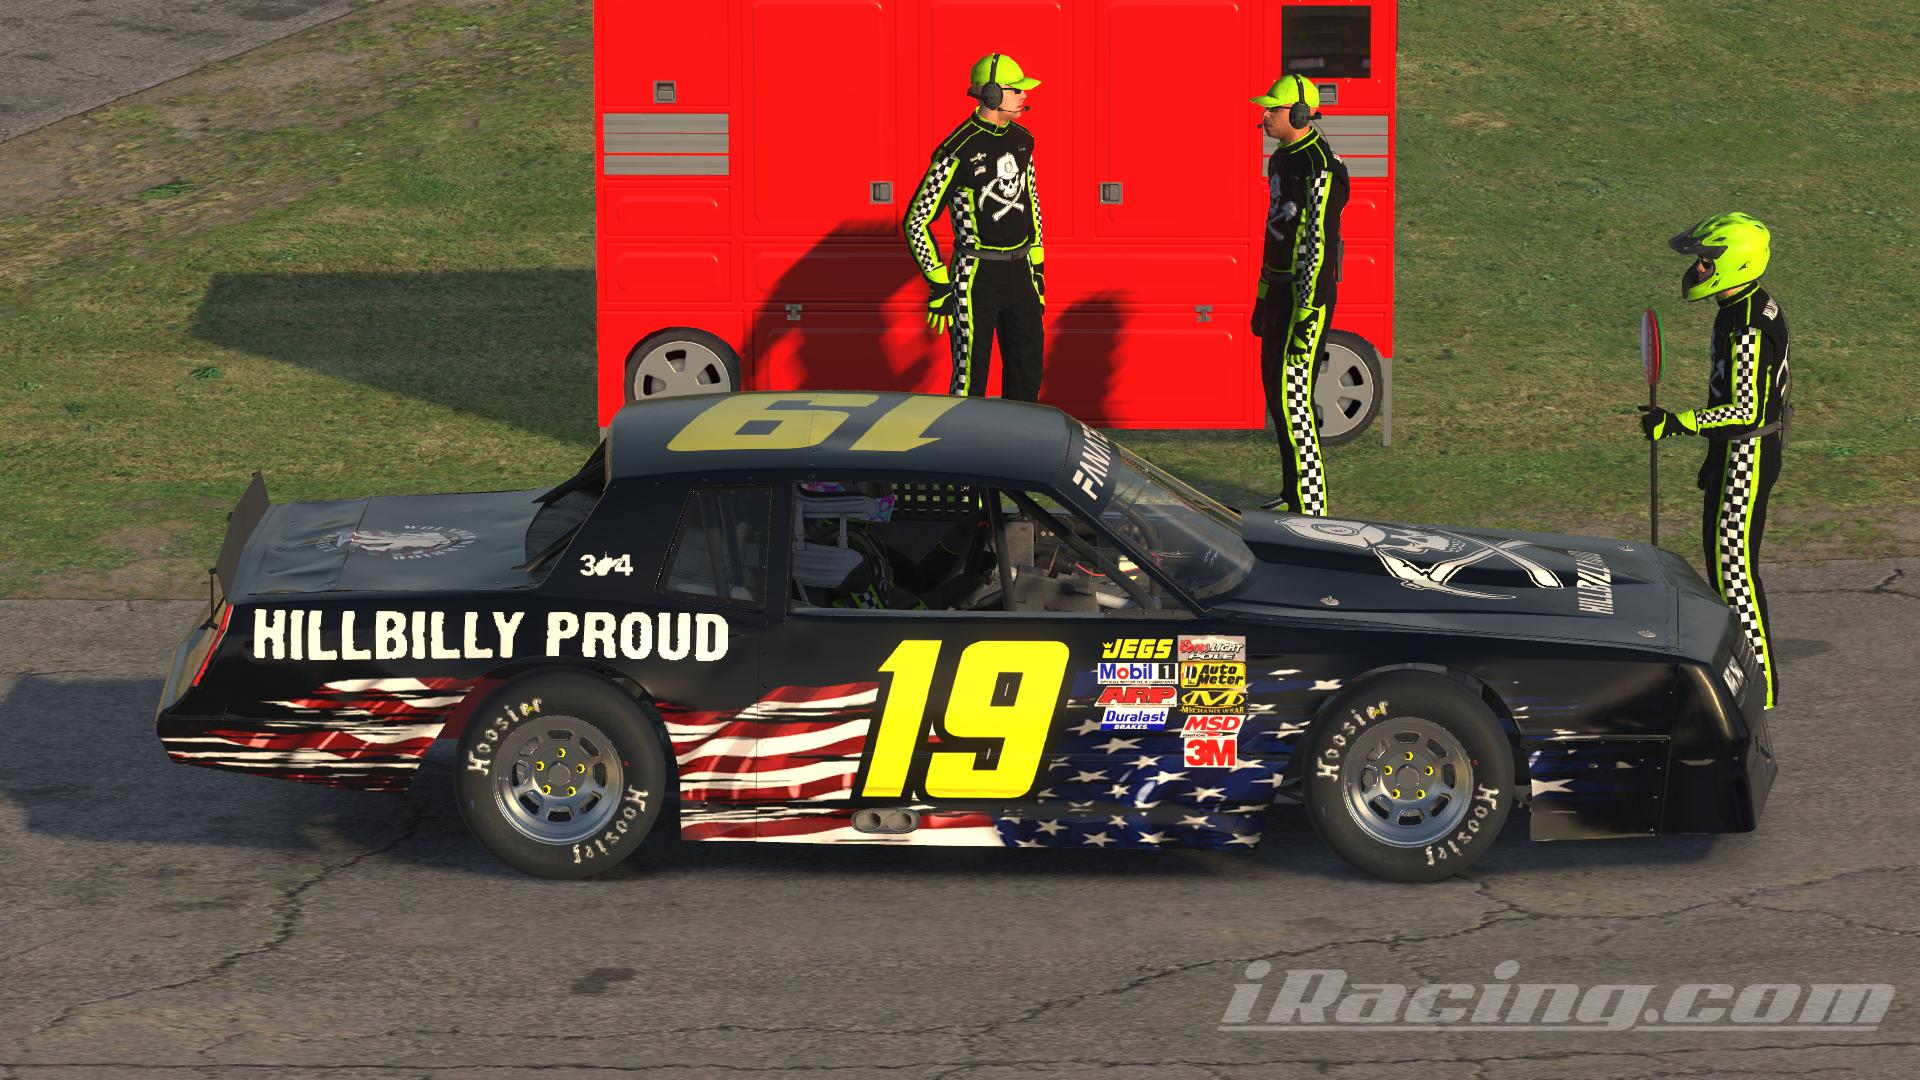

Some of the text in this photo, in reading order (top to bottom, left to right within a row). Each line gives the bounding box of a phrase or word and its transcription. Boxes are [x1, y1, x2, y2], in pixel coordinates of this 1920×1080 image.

[252, 608, 730, 662] HILLBILLY PROUD
[1102, 638, 1174, 659] JEGS
[1209, 642, 1244, 653] LIGHT
[1100, 663, 1153, 679] Mobil
[1200, 664, 1238, 675] Auto
[1200, 674, 1244, 685] Meter
[1097, 686, 1176, 704] ARP
[1105, 710, 1166, 722] Duralast
[1181, 705, 1221, 714] MECHANIX
[861, 639, 1070, 799] 19
[1184, 716, 1241, 731] MSD
[1185, 739, 1236, 767] 3M
